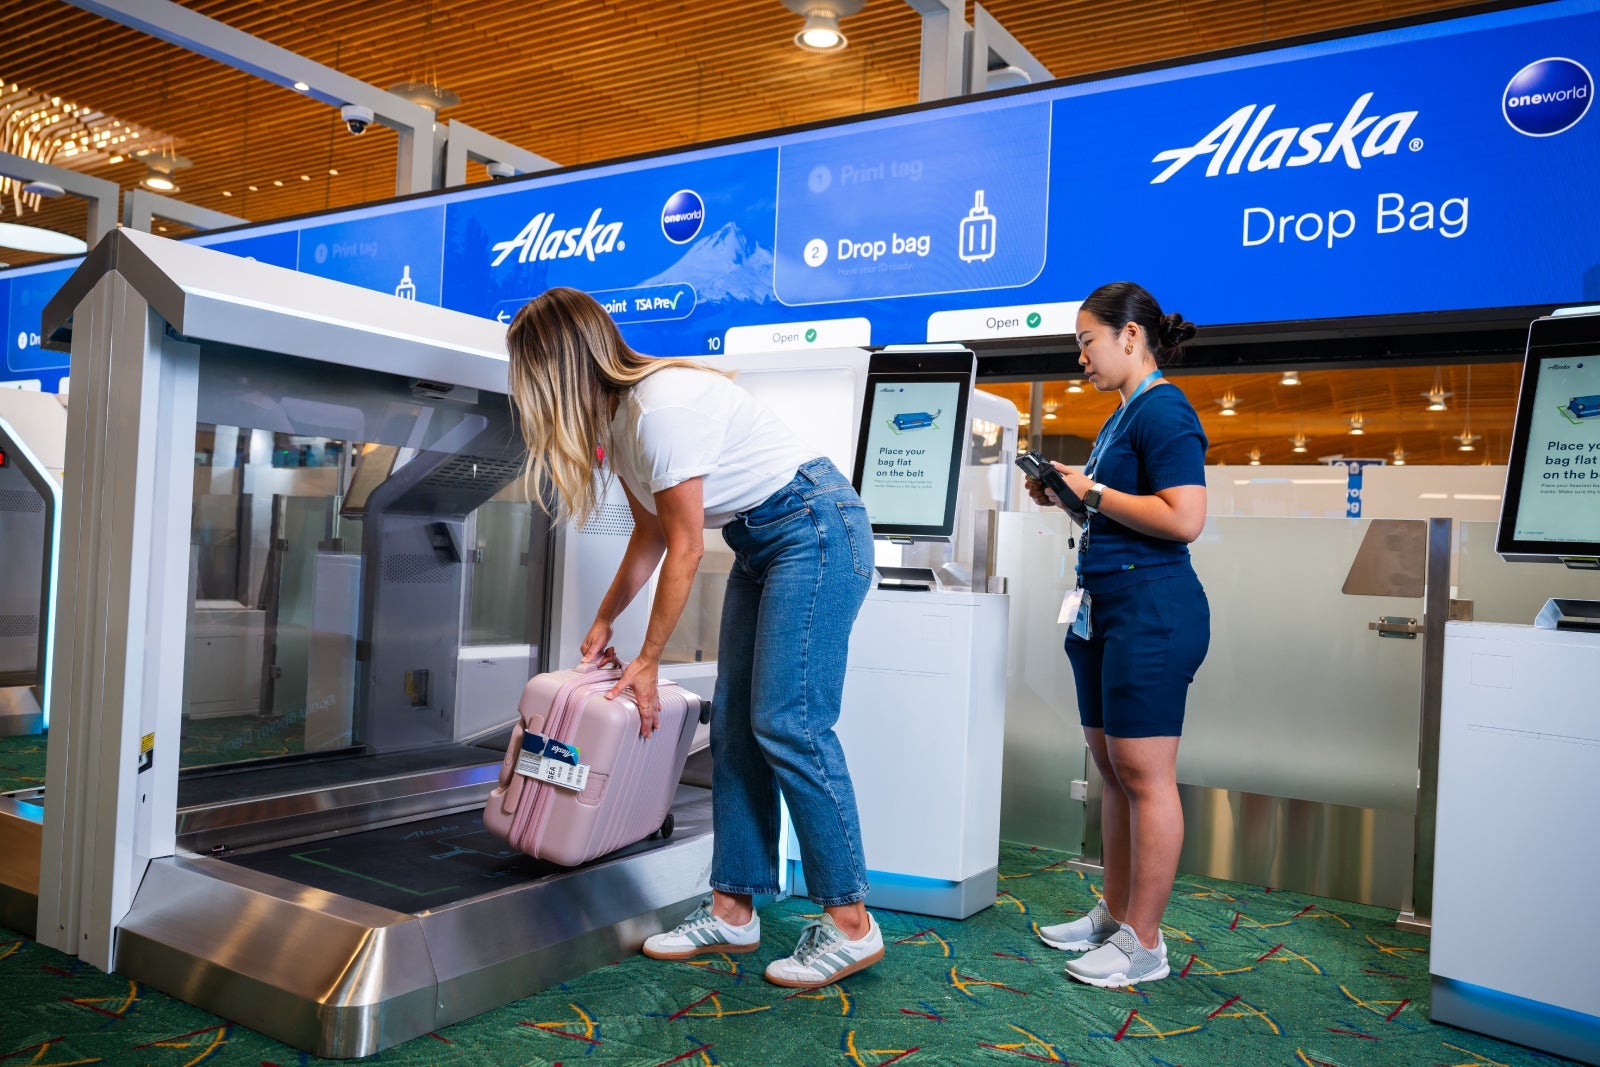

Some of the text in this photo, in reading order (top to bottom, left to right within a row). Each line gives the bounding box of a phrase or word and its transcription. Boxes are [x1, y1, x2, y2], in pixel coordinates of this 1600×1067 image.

[1508, 84, 1587, 108] oneworld
[841, 163, 885, 187] Print
[891, 160, 923, 181] tag
[663, 209, 702, 224] oneworld
[1242, 192, 1469, 249] Drop Bag
[837, 238, 887, 262] Drop
[892, 232, 931, 257] bag
[635, 299, 653, 311] TSA
[986, 317, 1019, 331] Open
[707, 332, 799, 351] 10 Open
[879, 447, 926, 457] Place your
[1547, 441, 1600, 452] Place yo
[877, 457, 912, 468] bag flat
[1545, 454, 1597, 467] bag flat
[890, 469, 904, 477] the
[1563, 469, 1586, 479] the
[548, 766, 557, 780] SEA
